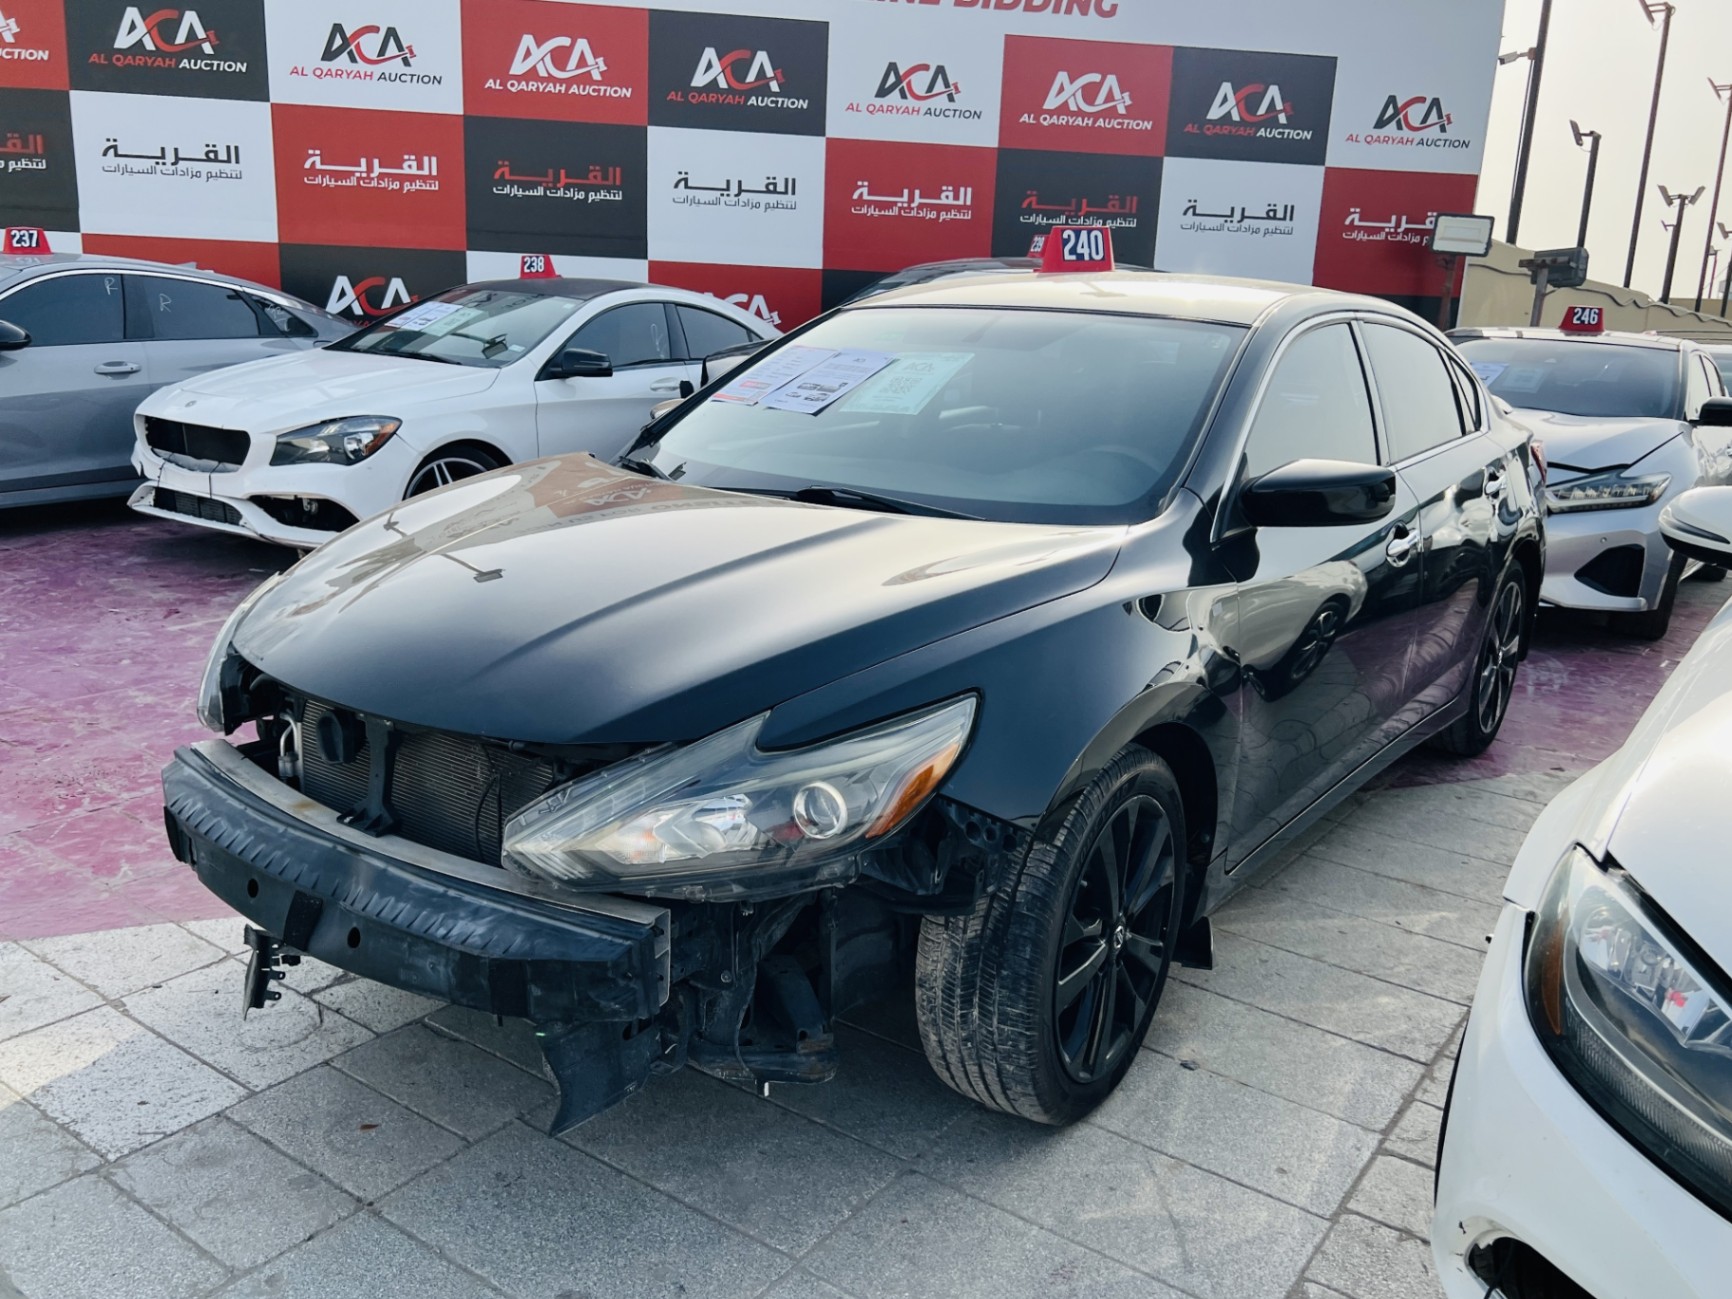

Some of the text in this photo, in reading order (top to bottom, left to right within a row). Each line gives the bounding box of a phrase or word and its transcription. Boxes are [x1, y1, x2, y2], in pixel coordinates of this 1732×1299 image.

[114, 7, 215, 54] ACA
[0, 48, 49, 60] CTION
[321, 23, 412, 67] ACA
[89, 53, 247, 72] AL QARYAH AUCTION
[509, 34, 602, 80] ACA
[290, 66, 442, 85] AL QARYAH AUCTION
[691, 47, 780, 92] ACA
[485, 79, 632, 97] AL QARYAH AUCTION
[875, 62, 955, 103] ACA
[667, 91, 808, 109] AL QARYAH AUCTION
[1043, 71, 1127, 114] ACA
[846, 103, 982, 119] AL QARYAH AUCTION
[1206, 82, 1287, 124] ACA
[1020, 114, 1152, 129] AL QARYAH AUCTION
[1373, 95, 1448, 133] ACA
[1184, 123, 1312, 139] AL QARYAH AUCTION
[1346, 134, 1470, 148] AL QARYAH AUCTION
[102, 138, 240, 165] القرية
[8, 159, 46, 172] لتنظيم
[102, 163, 242, 182] لتنظيم مزادات السيارات
[304, 150, 437, 178] القرية
[304, 174, 438, 193] لتنظيم مزادات السيارات
[494, 161, 621, 187] القرية
[493, 184, 622, 203] لتنظيم مزادات السيارات
[674, 171, 796, 197] القرية
[853, 181, 972, 206] القرية
[673, 195, 796, 212] لتنظيم مزادات السيارات
[1022, 191, 1137, 216] القرية
[1183, 200, 1294, 223] القرية
[852, 205, 971, 222] لتنظيم مزادات السيارات
[1020, 213, 1068, 225] السيارات
[1070, 216, 1103, 227] مزادات
[1344, 208, 1436, 232] قرية
[1181, 221, 1293, 237] لتنظيم مزادات السيارات
[1343, 228, 1388, 241] السيارات
[1389, 230, 1420, 243] مزادات
[11, 230, 38, 248] 237
[1062, 229, 1104, 261] 240
[524, 256, 545, 273] 238
[159, 293, 172, 312] R
[325, 276, 413, 317] ACA
[1572, 307, 1600, 325] 246
